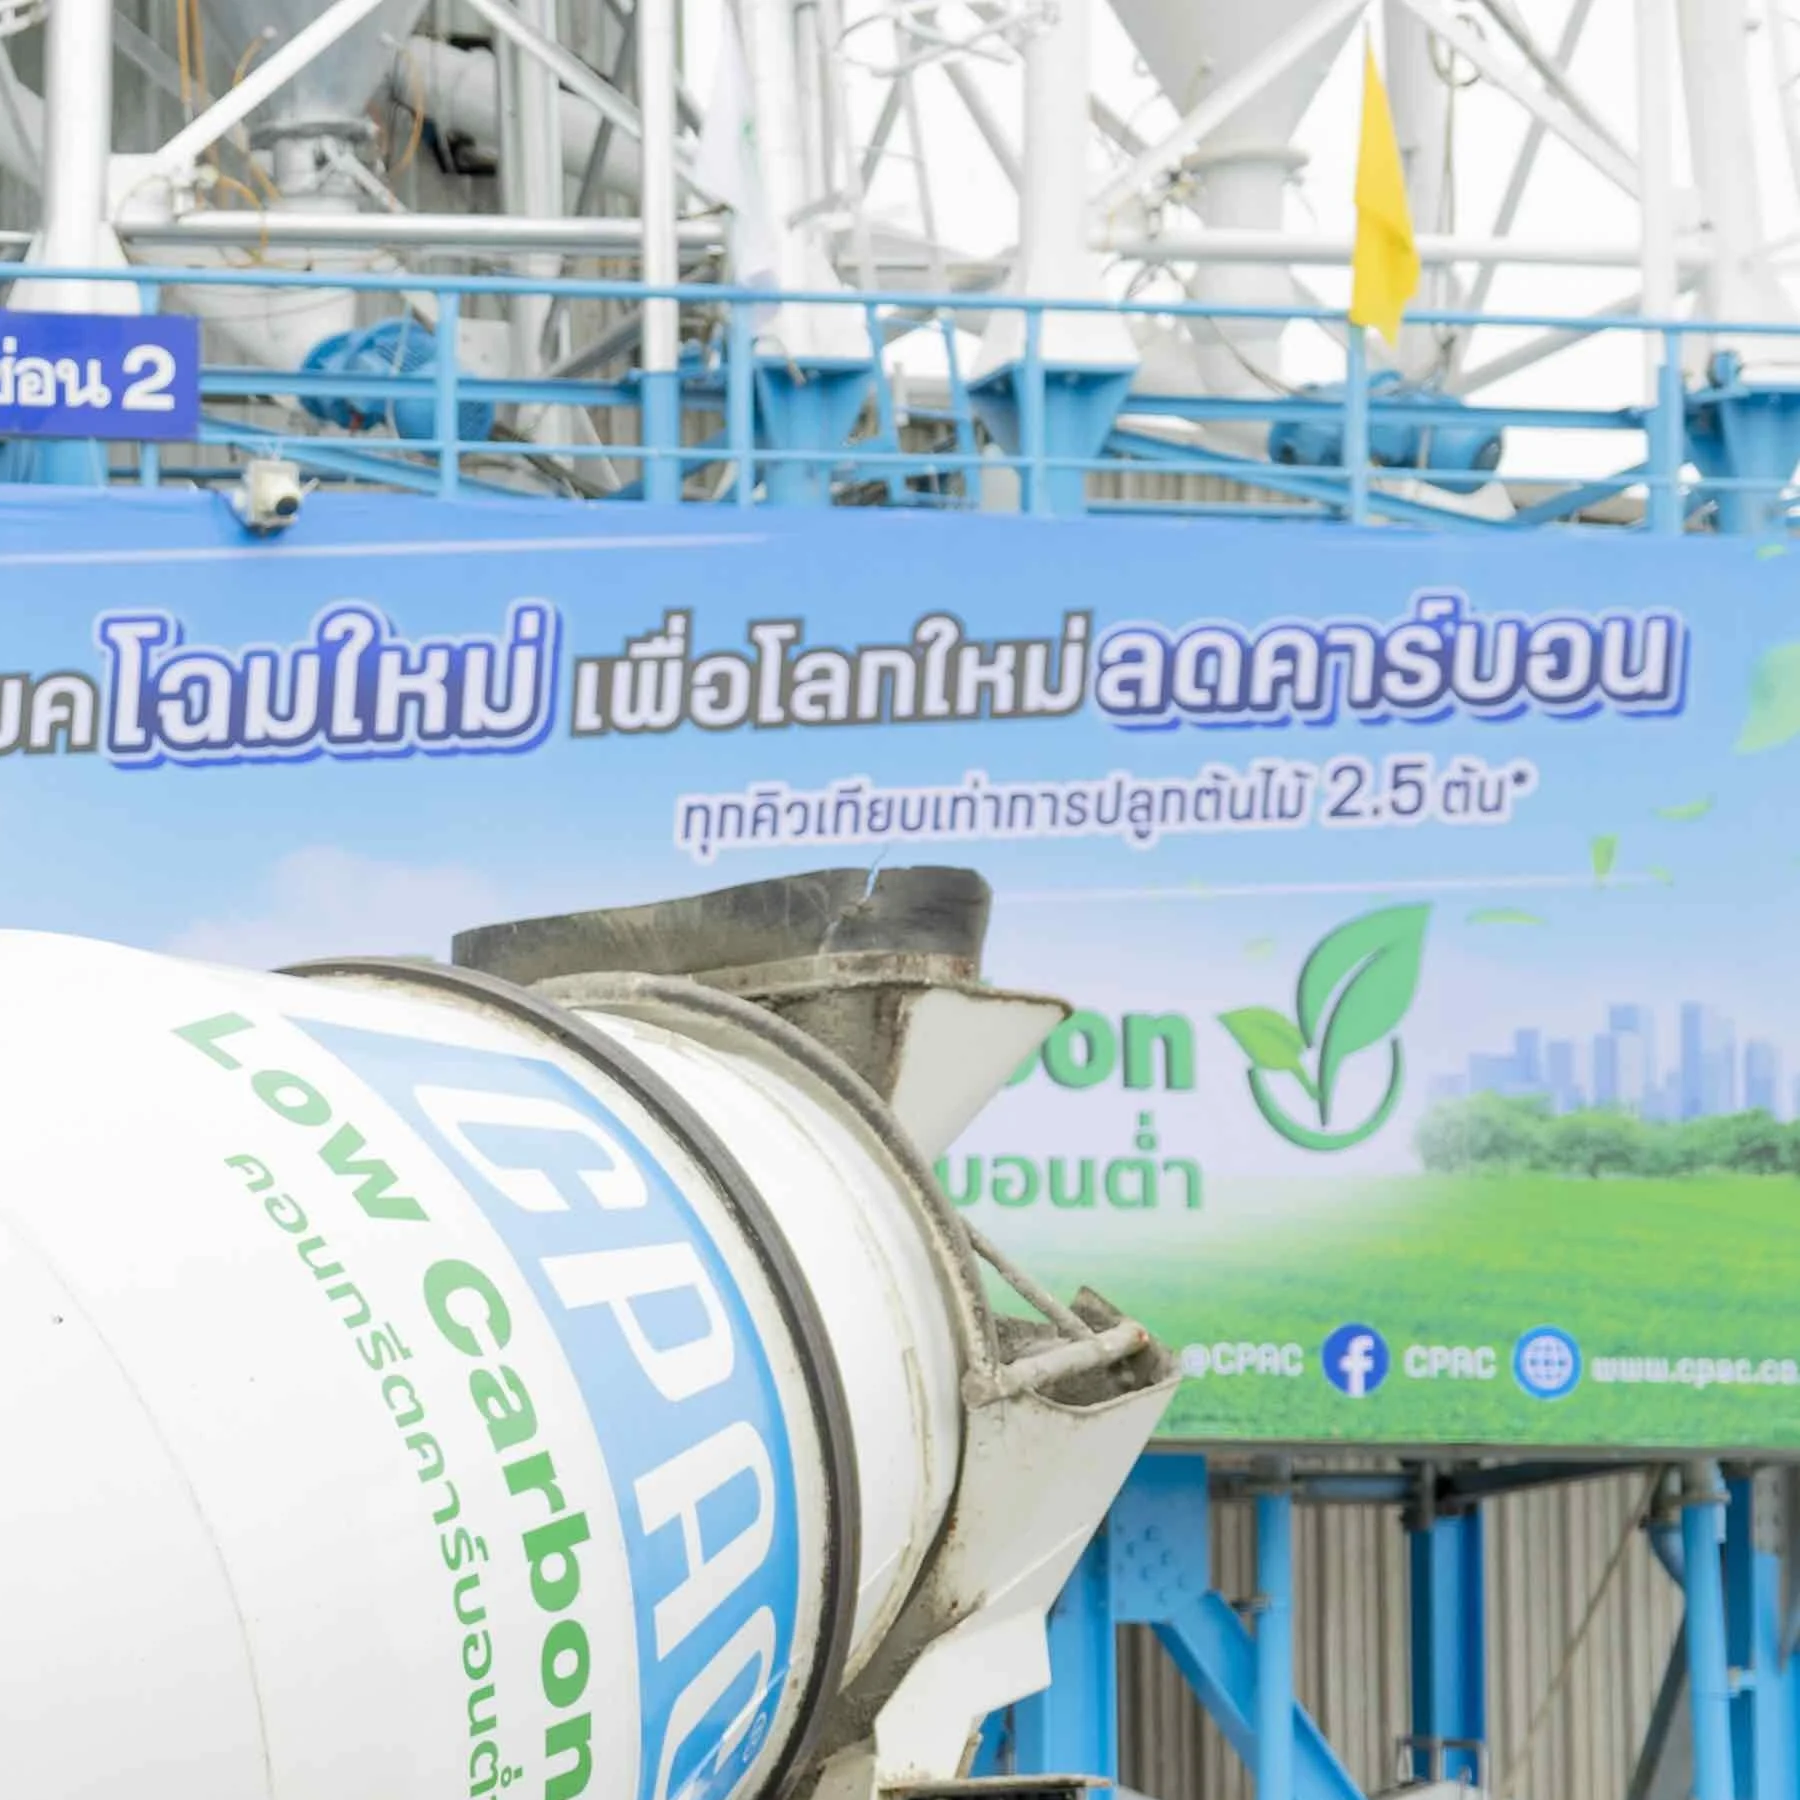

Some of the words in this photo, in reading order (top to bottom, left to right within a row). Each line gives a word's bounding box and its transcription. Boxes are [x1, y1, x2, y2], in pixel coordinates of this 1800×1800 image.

[121, 343, 177, 411] 2
[1328, 762, 1426, 818] 2.5
[169, 1010, 431, 1223] Low
[1403, 1345, 1497, 1380] CPAC
